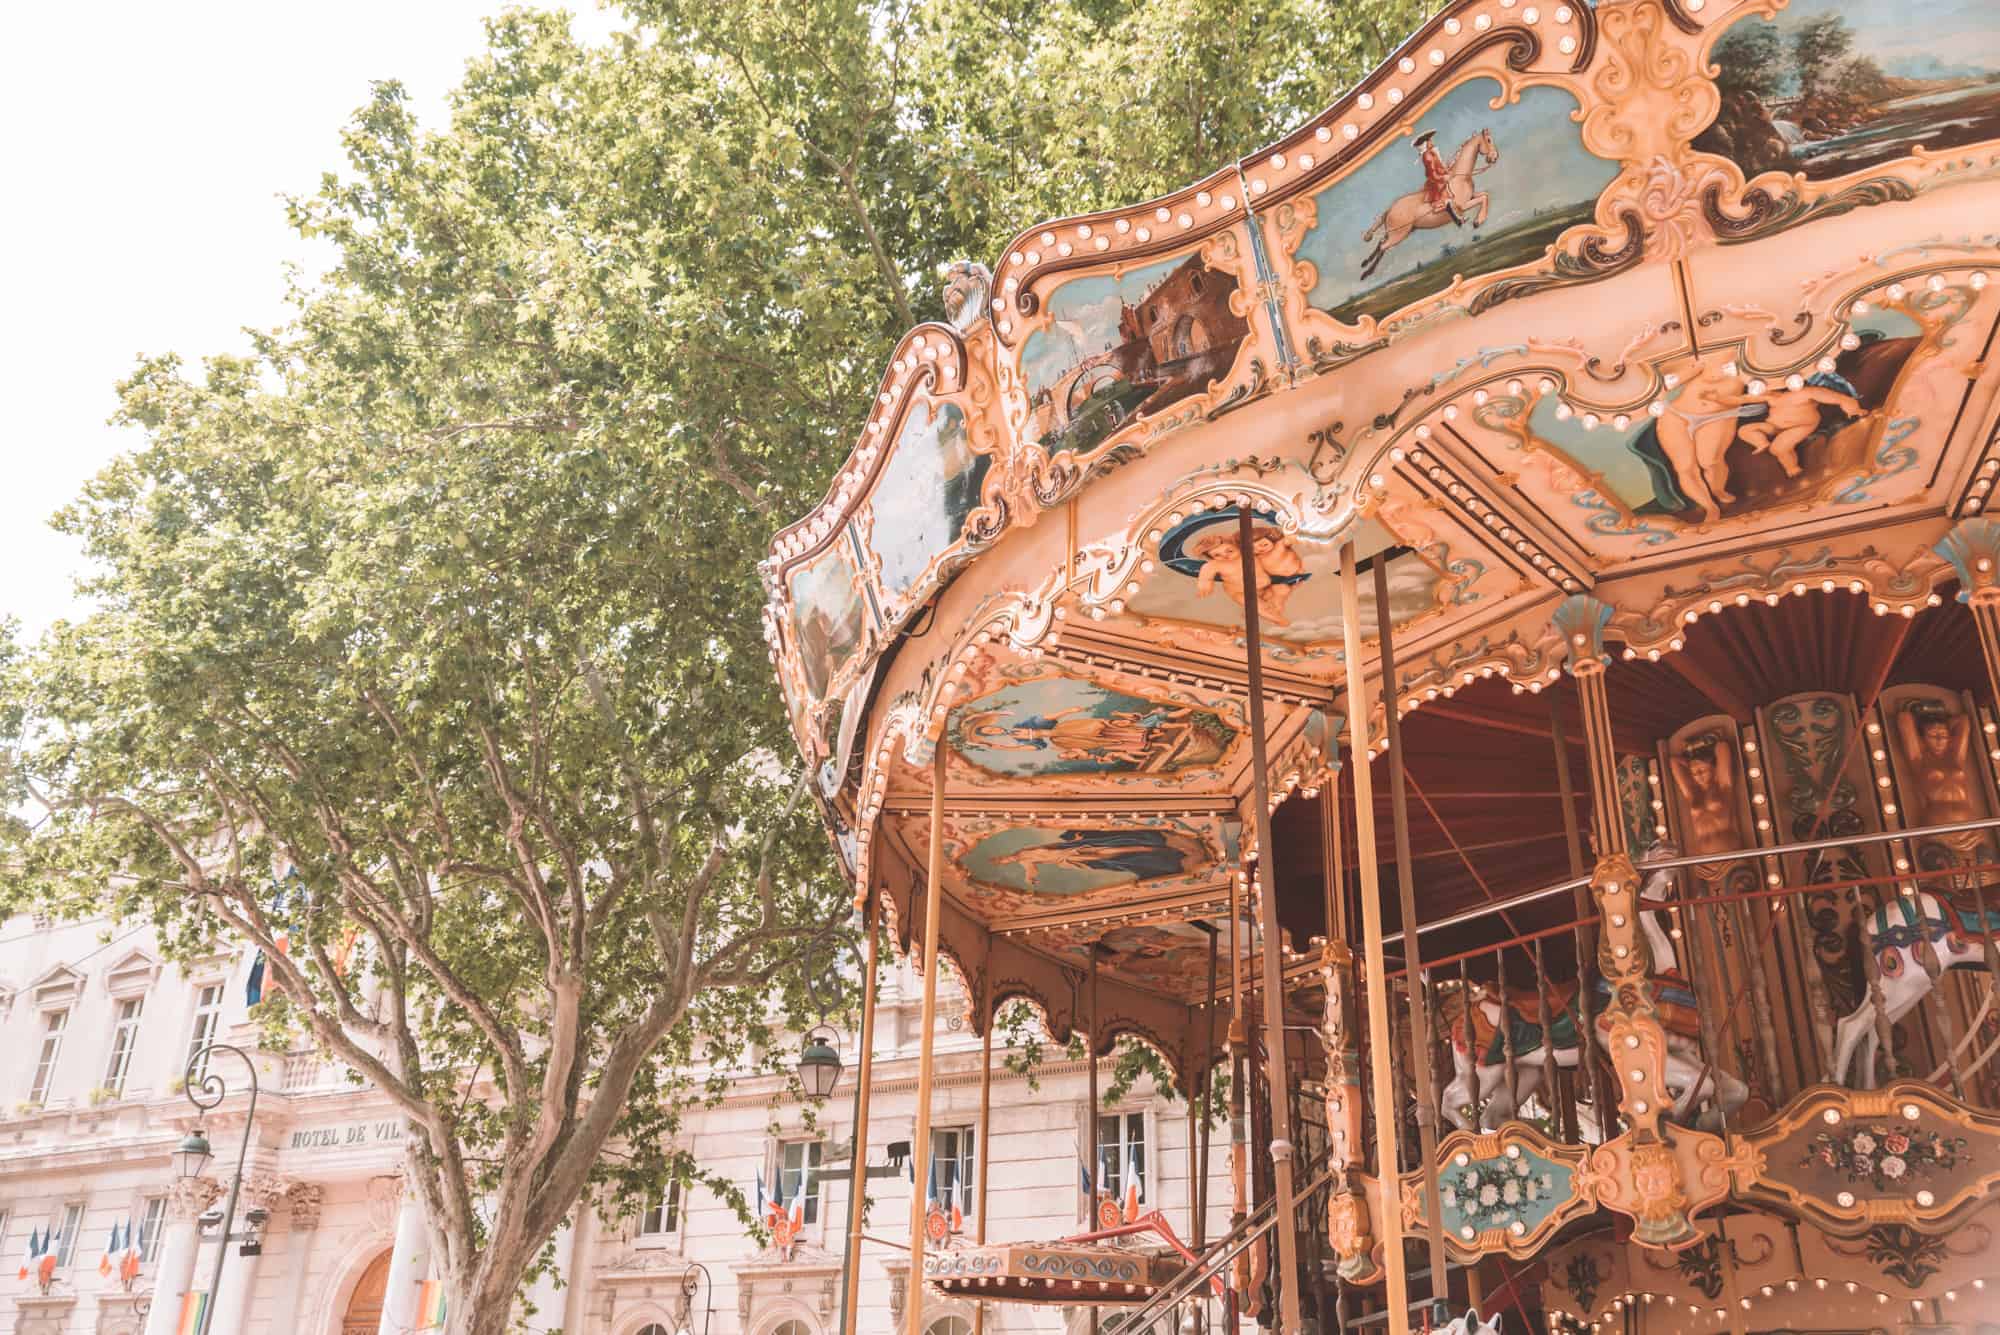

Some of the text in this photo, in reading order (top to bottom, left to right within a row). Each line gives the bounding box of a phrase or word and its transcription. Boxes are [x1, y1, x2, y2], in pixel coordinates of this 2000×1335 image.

[291, 1121, 402, 1149] HOTEL DE VIL
